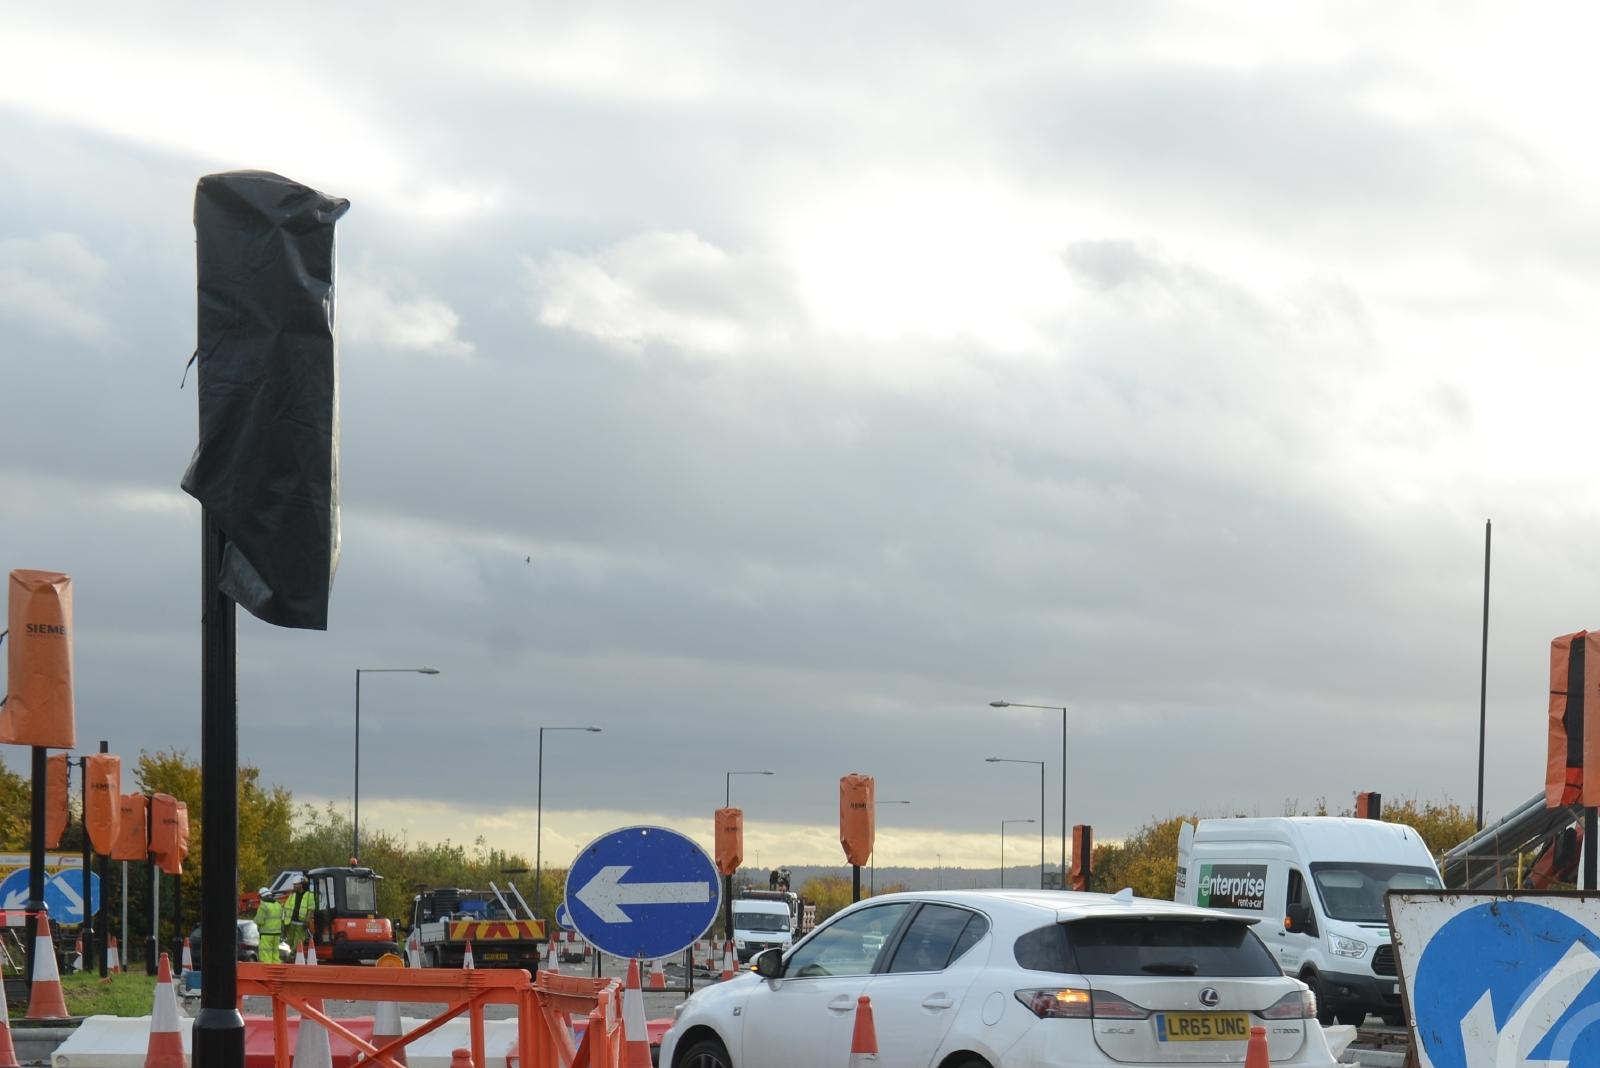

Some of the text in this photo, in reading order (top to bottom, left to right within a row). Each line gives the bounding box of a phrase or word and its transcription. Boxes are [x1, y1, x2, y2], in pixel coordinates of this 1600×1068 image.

[1199, 872, 1265, 902] enterprise
[1237, 898, 1263, 908] rent-a-car
[1167, 1017, 1247, 1036] LR65 UNG
